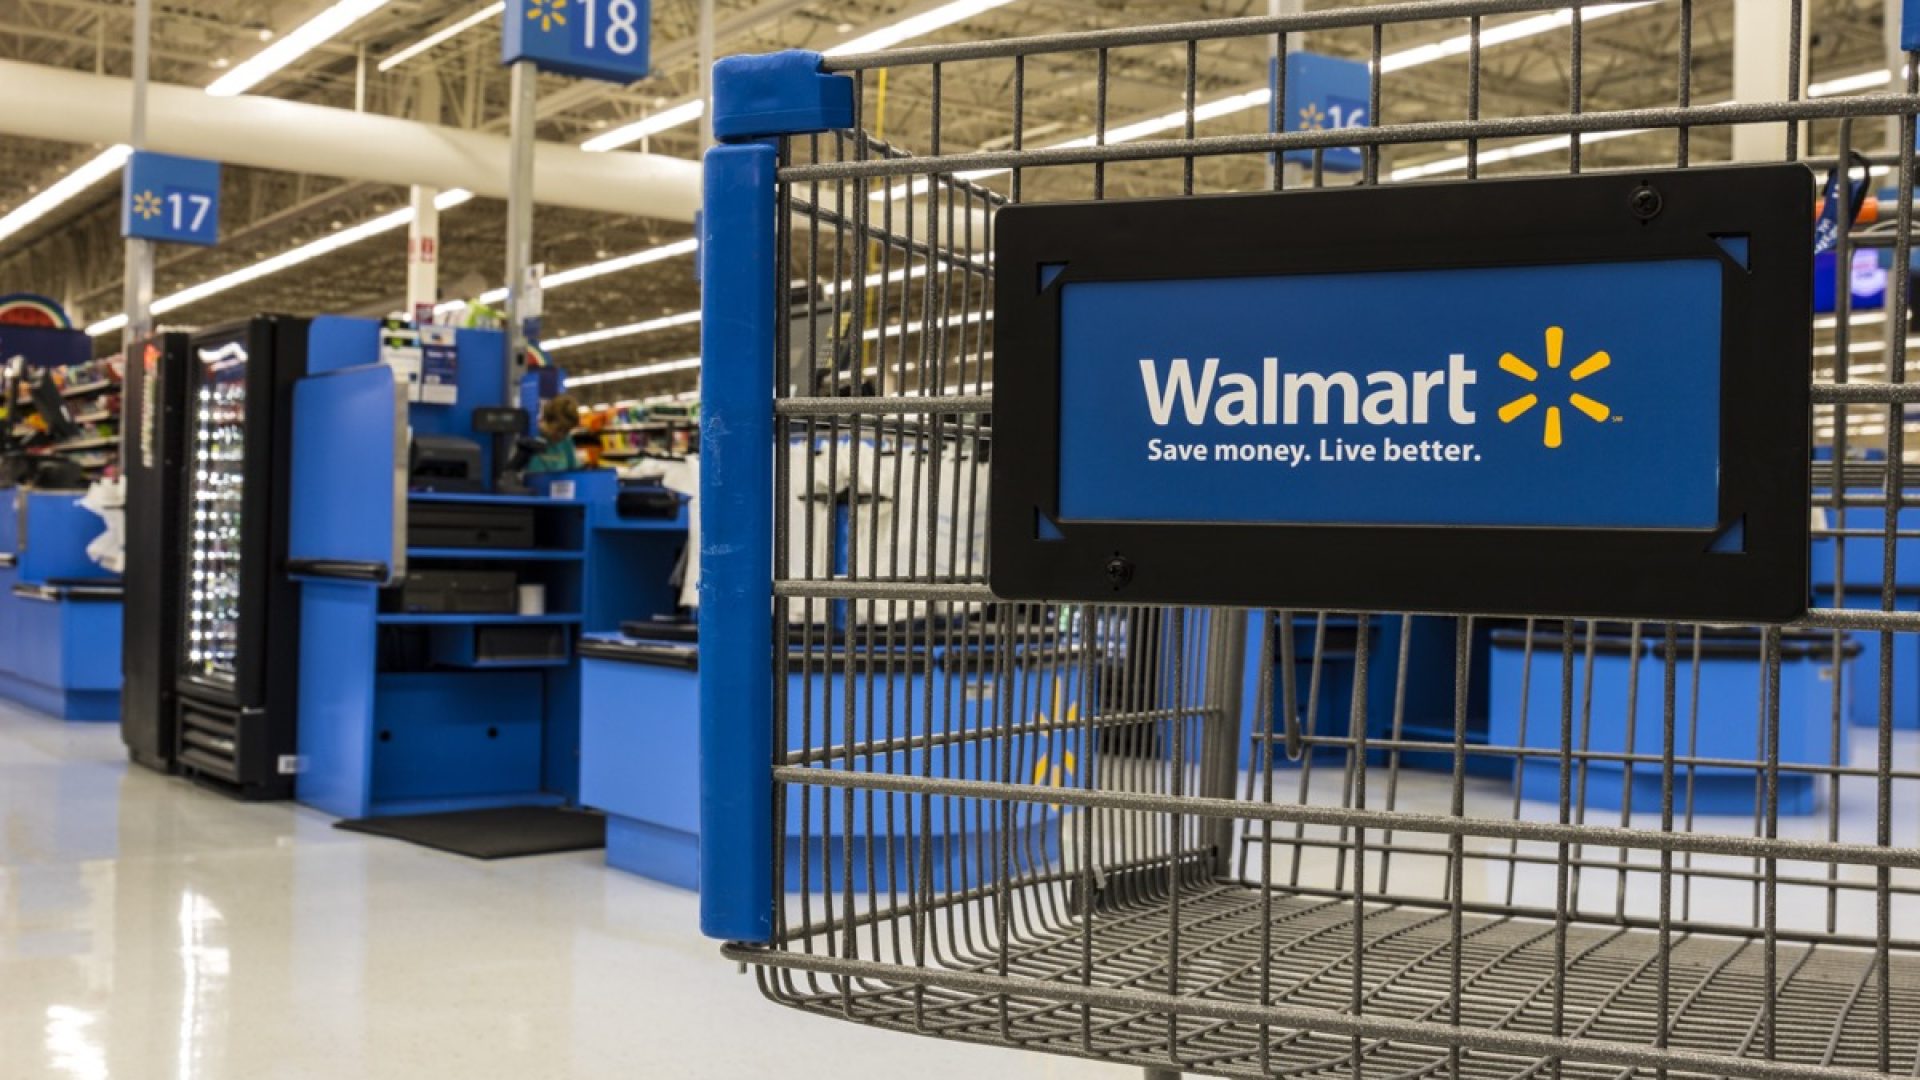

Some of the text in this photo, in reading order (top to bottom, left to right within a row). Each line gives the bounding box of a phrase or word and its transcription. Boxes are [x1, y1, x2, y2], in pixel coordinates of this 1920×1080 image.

[577, 0, 638, 55] 18
[168, 192, 211, 232] 17
[1138, 353, 1477, 426] Walmart
[1148, 437, 1481, 468] Save money. Live better.
